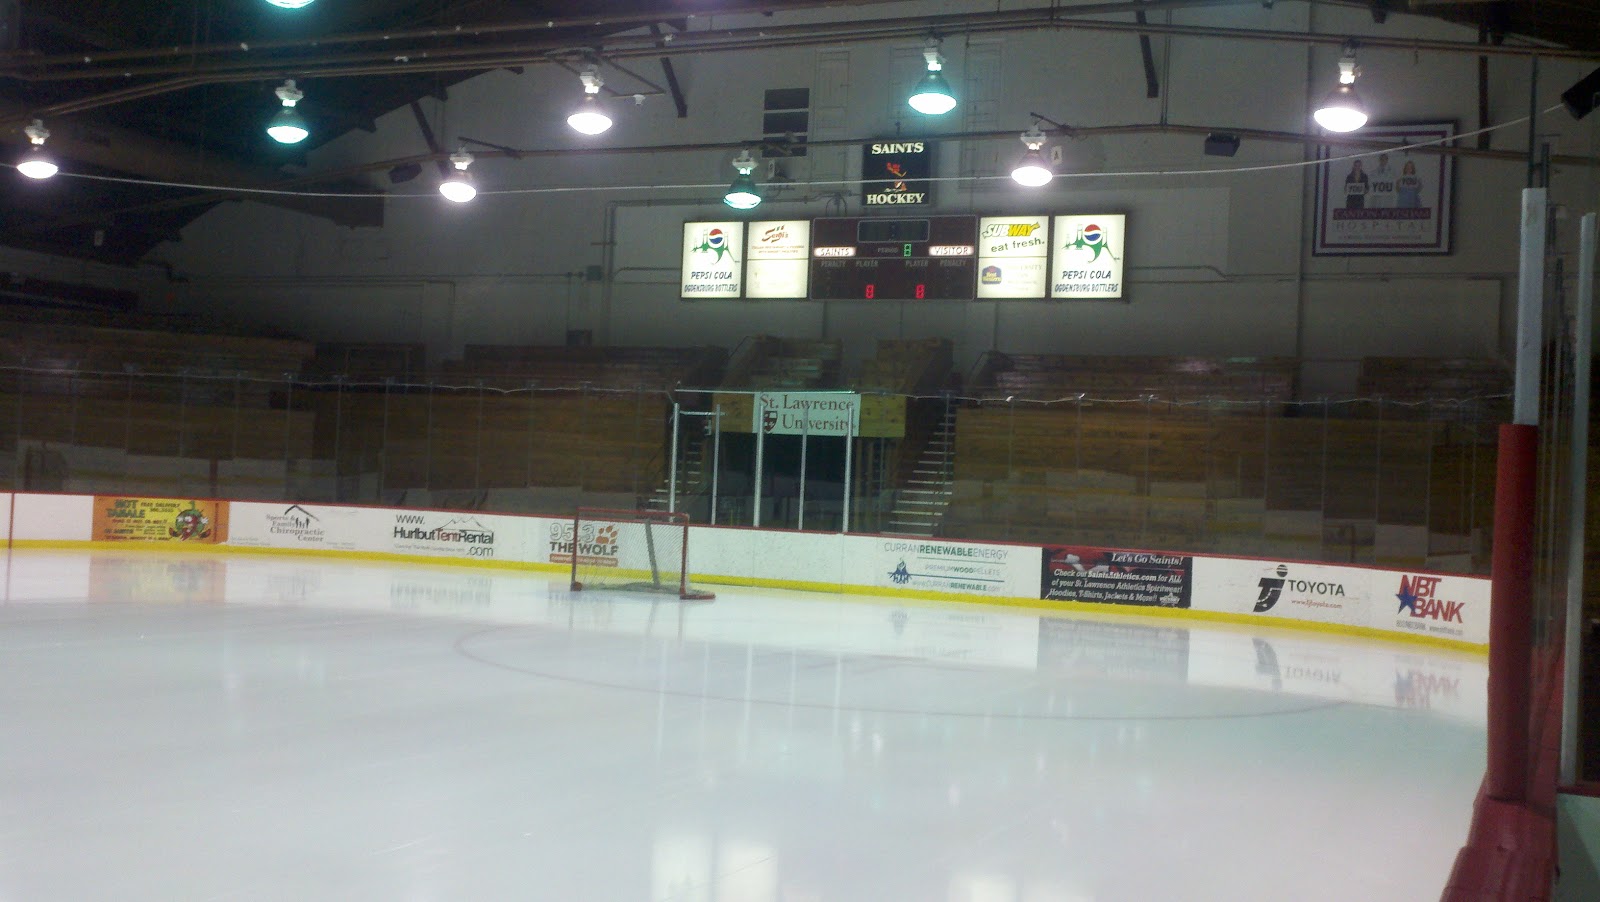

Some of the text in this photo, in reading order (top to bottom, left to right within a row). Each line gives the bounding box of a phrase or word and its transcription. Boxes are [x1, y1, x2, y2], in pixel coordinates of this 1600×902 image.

[871, 142, 925, 155] SAINTS
[1372, 181, 1393, 193] YOU
[1401, 177, 1418, 186] YOU
[866, 192, 926, 205] HOCKEY
[982, 222, 1041, 239] SUBWAY
[934, 246, 969, 255] VISITOR
[991, 237, 1046, 252] eat fresh.
[820, 248, 850, 256] SAINTS
[821, 260, 879, 268] PENALTY PLAYER
[939, 259, 967, 267] PENALTY
[690, 271, 733, 280] PEPSI COLA
[1062, 270, 1112, 279] PEPSI COLA
[684, 284, 738, 293] OGDENSBURG BOTTLERS
[1055, 283, 1119, 293] OGDENSBURG BOTTLERS
[760, 393, 855, 411] St. Lawrence
[782, 414, 852, 433] Unversit
[270, 527, 325, 537] Chiropractic
[297, 534, 324, 542] Center
[549, 541, 619, 556] THE WOLF
[1111, 552, 1184, 566] Let's Go Saints!
[1054, 568, 1075, 577] Check
[1169, 574, 1183, 583] ALL
[1084, 580, 1115, 589] Lawrence
[1116, 583, 1146, 591] Athletics
[1288, 579, 1345, 597] TOYOTA
[1398, 575, 1442, 598] NBT
[1410, 598, 1466, 624] BANK
